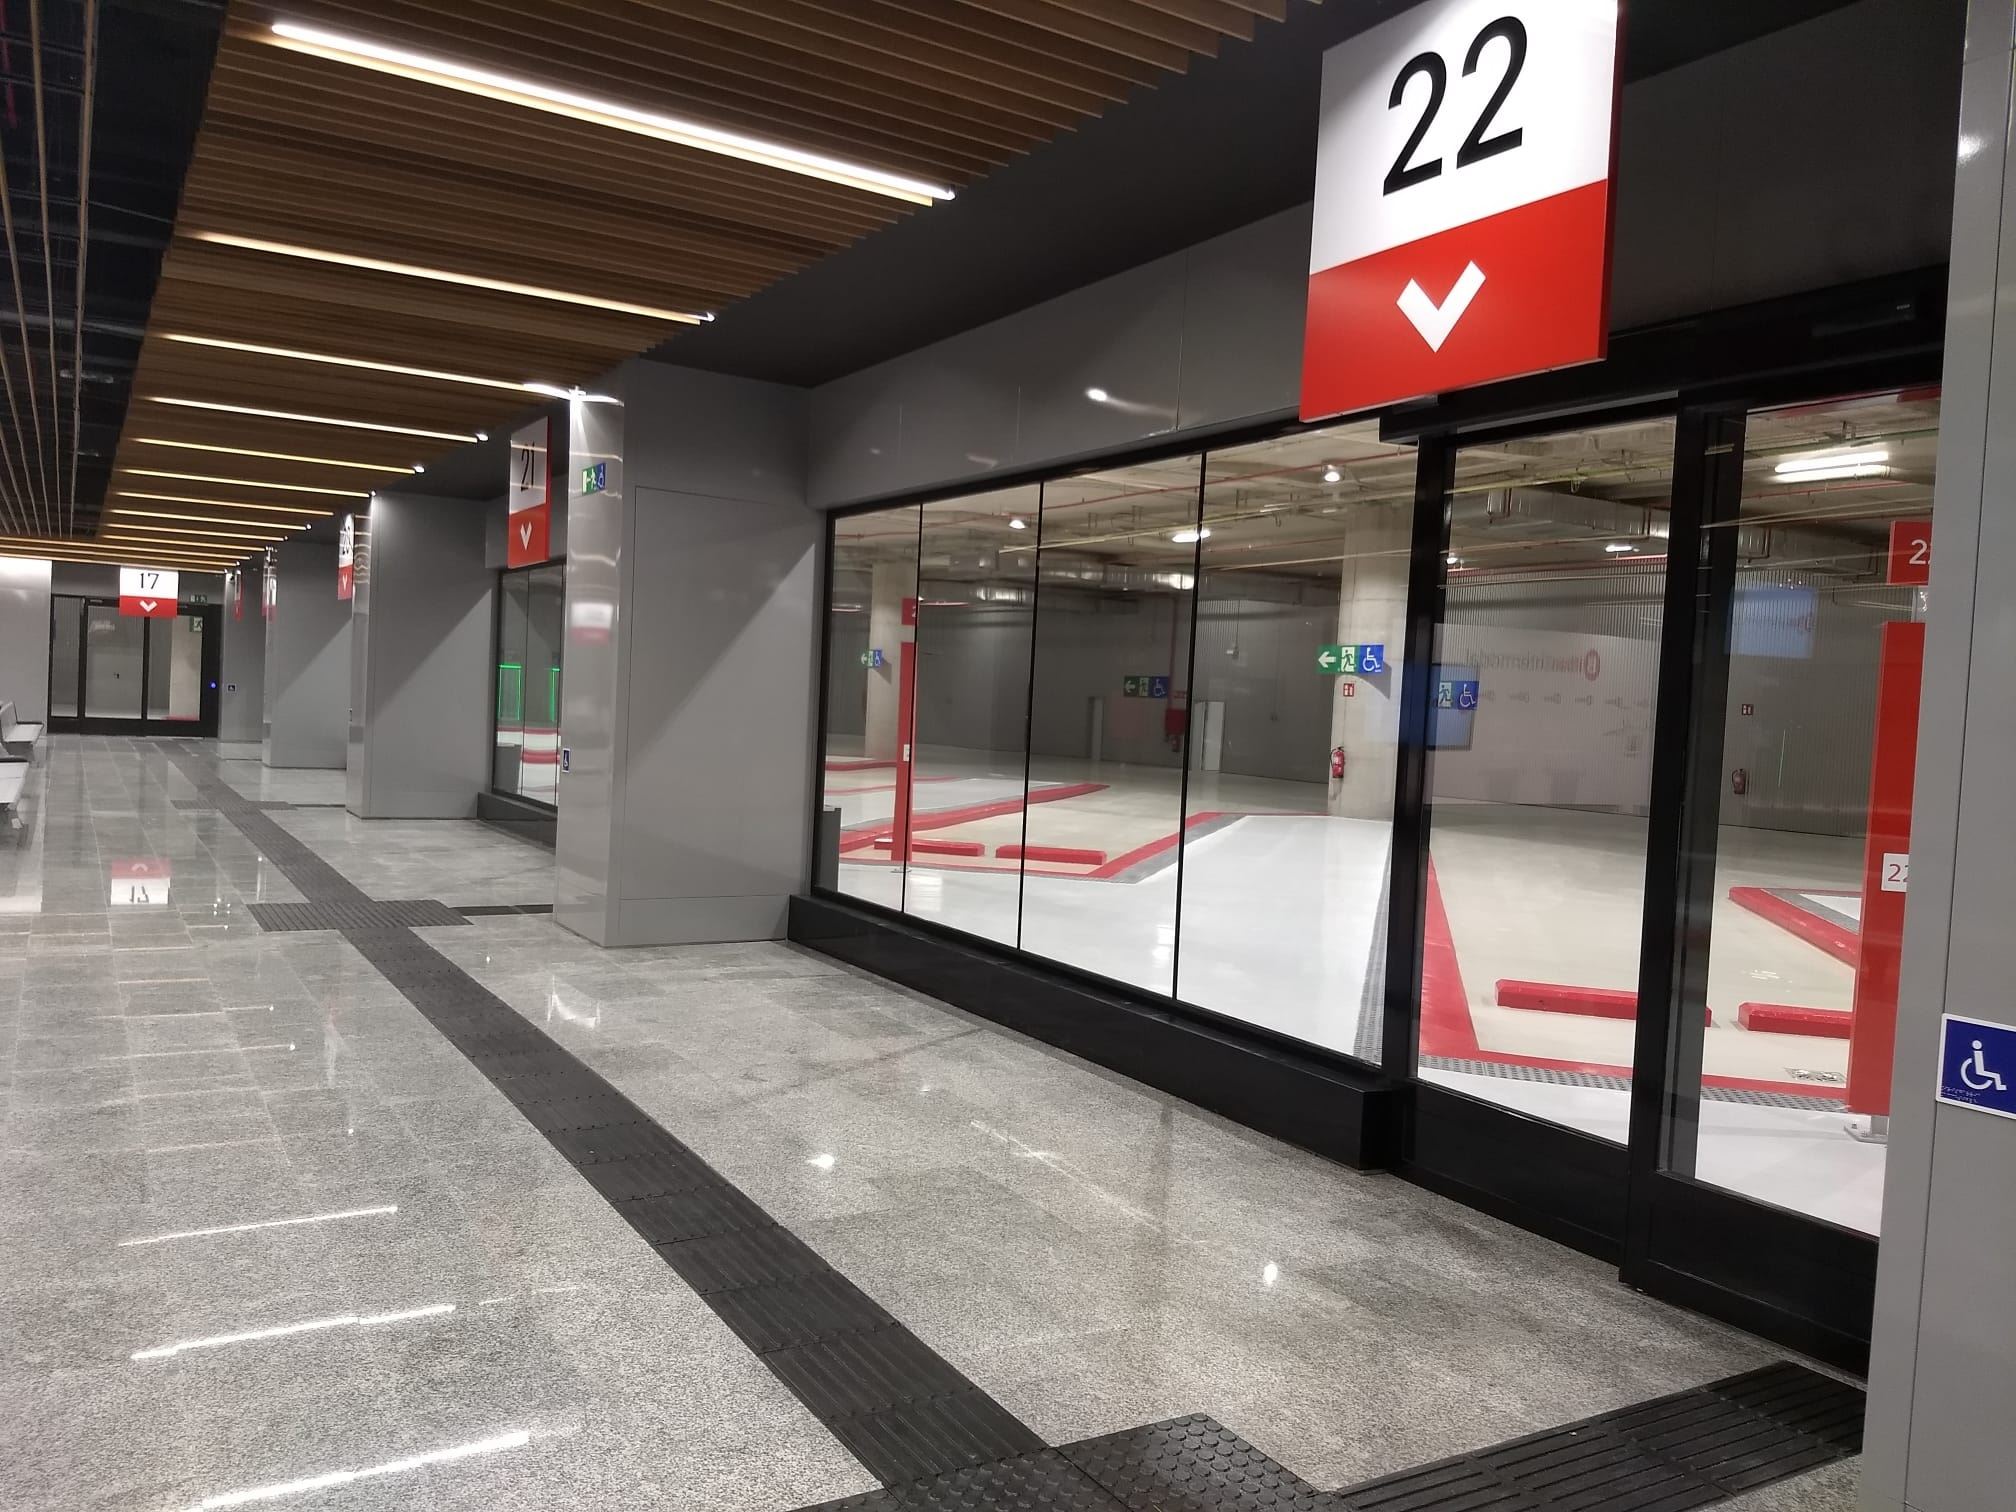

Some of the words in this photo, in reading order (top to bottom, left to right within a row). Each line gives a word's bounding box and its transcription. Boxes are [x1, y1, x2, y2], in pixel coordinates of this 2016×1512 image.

[1383, 15, 1528, 197] 22
[520, 441, 536, 492] 21
[1908, 538, 1931, 565] 2
[139, 572, 160, 590] 17
